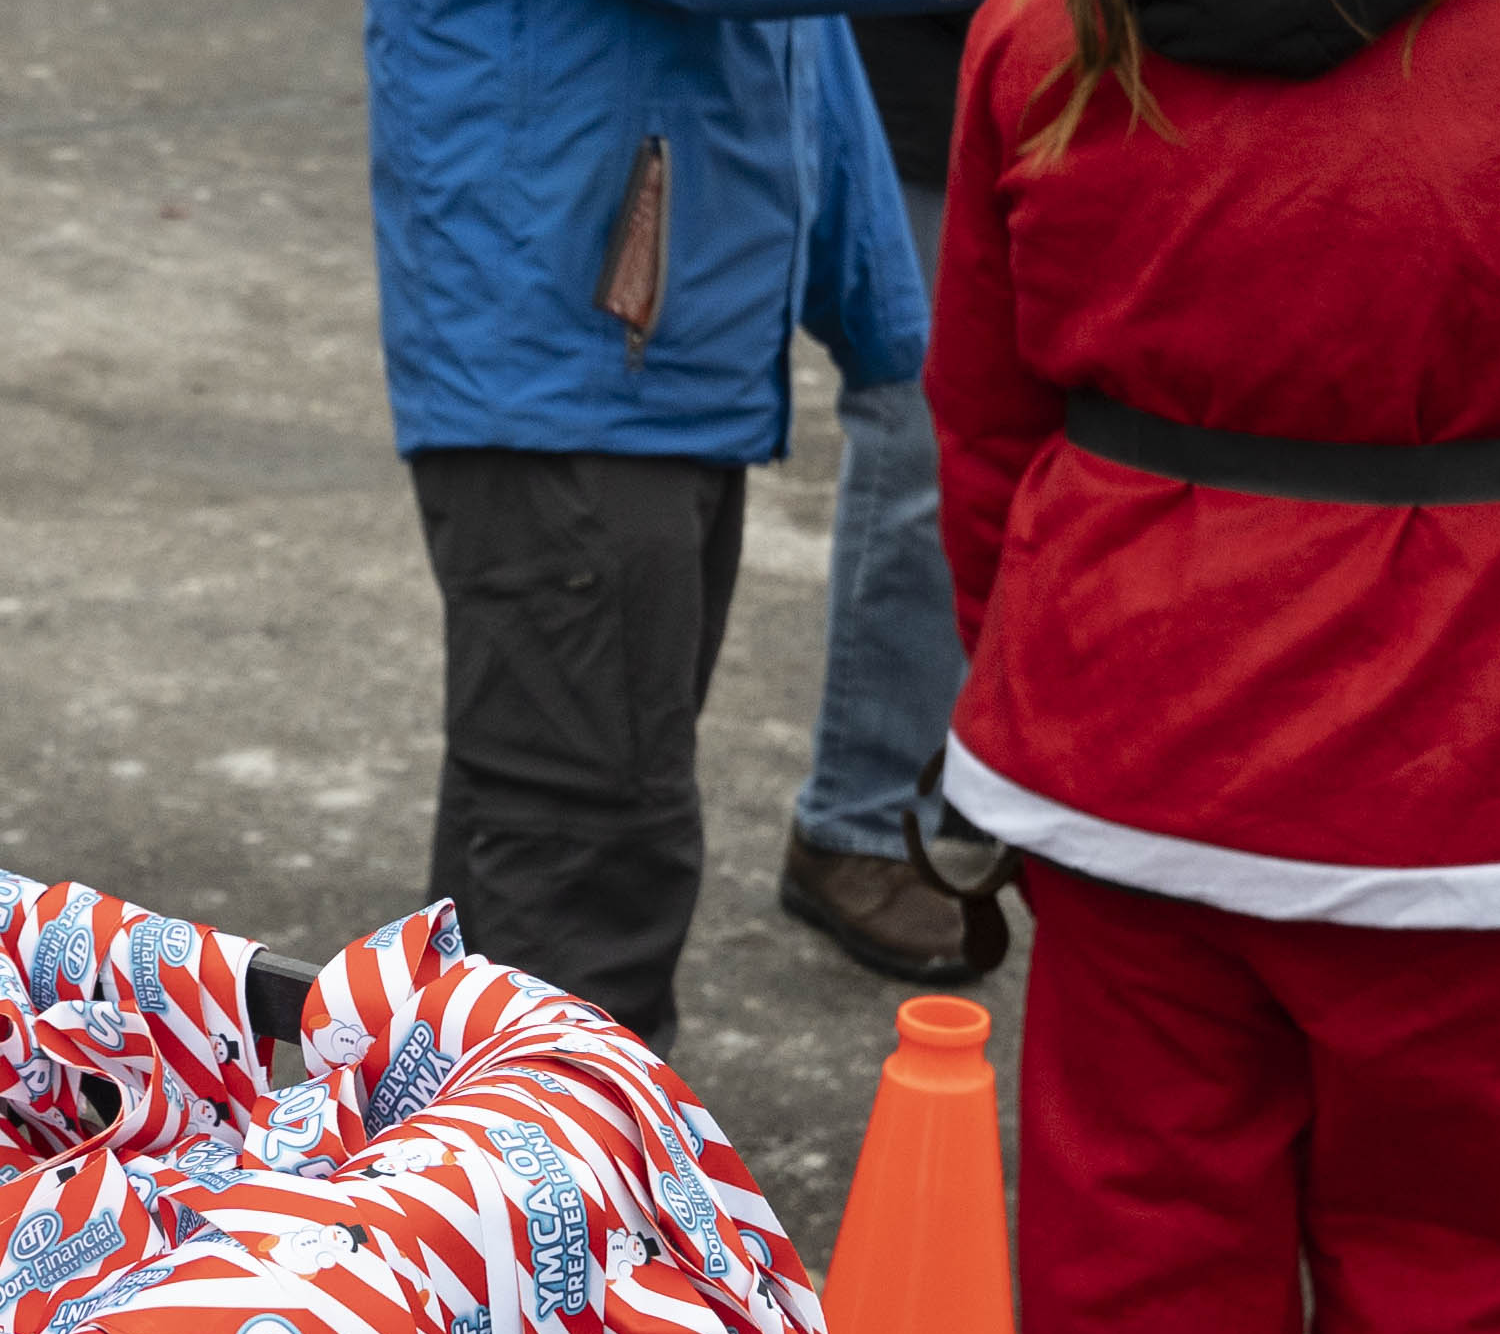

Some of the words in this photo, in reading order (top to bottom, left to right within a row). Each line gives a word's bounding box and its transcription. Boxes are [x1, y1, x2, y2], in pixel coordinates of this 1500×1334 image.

[64, 893, 97, 928] Dort
[62, 929, 91, 983] df
[143, 923, 165, 1010] Financial
[162, 924, 194, 963] df
[500, 1130, 542, 1180] OF
[524, 1122, 563, 1187] FLINT
[661, 1172, 700, 1230] df
[13, 1215, 61, 1260] df
[35, 1213, 116, 1278] Financial
[38, 1259, 81, 1288] CREDIT
[79, 1236, 120, 1264] UNION
[530, 1184, 562, 1319] YMCA
[554, 1191, 586, 1313] GREATER
[707, 1224, 729, 1274] Dort
